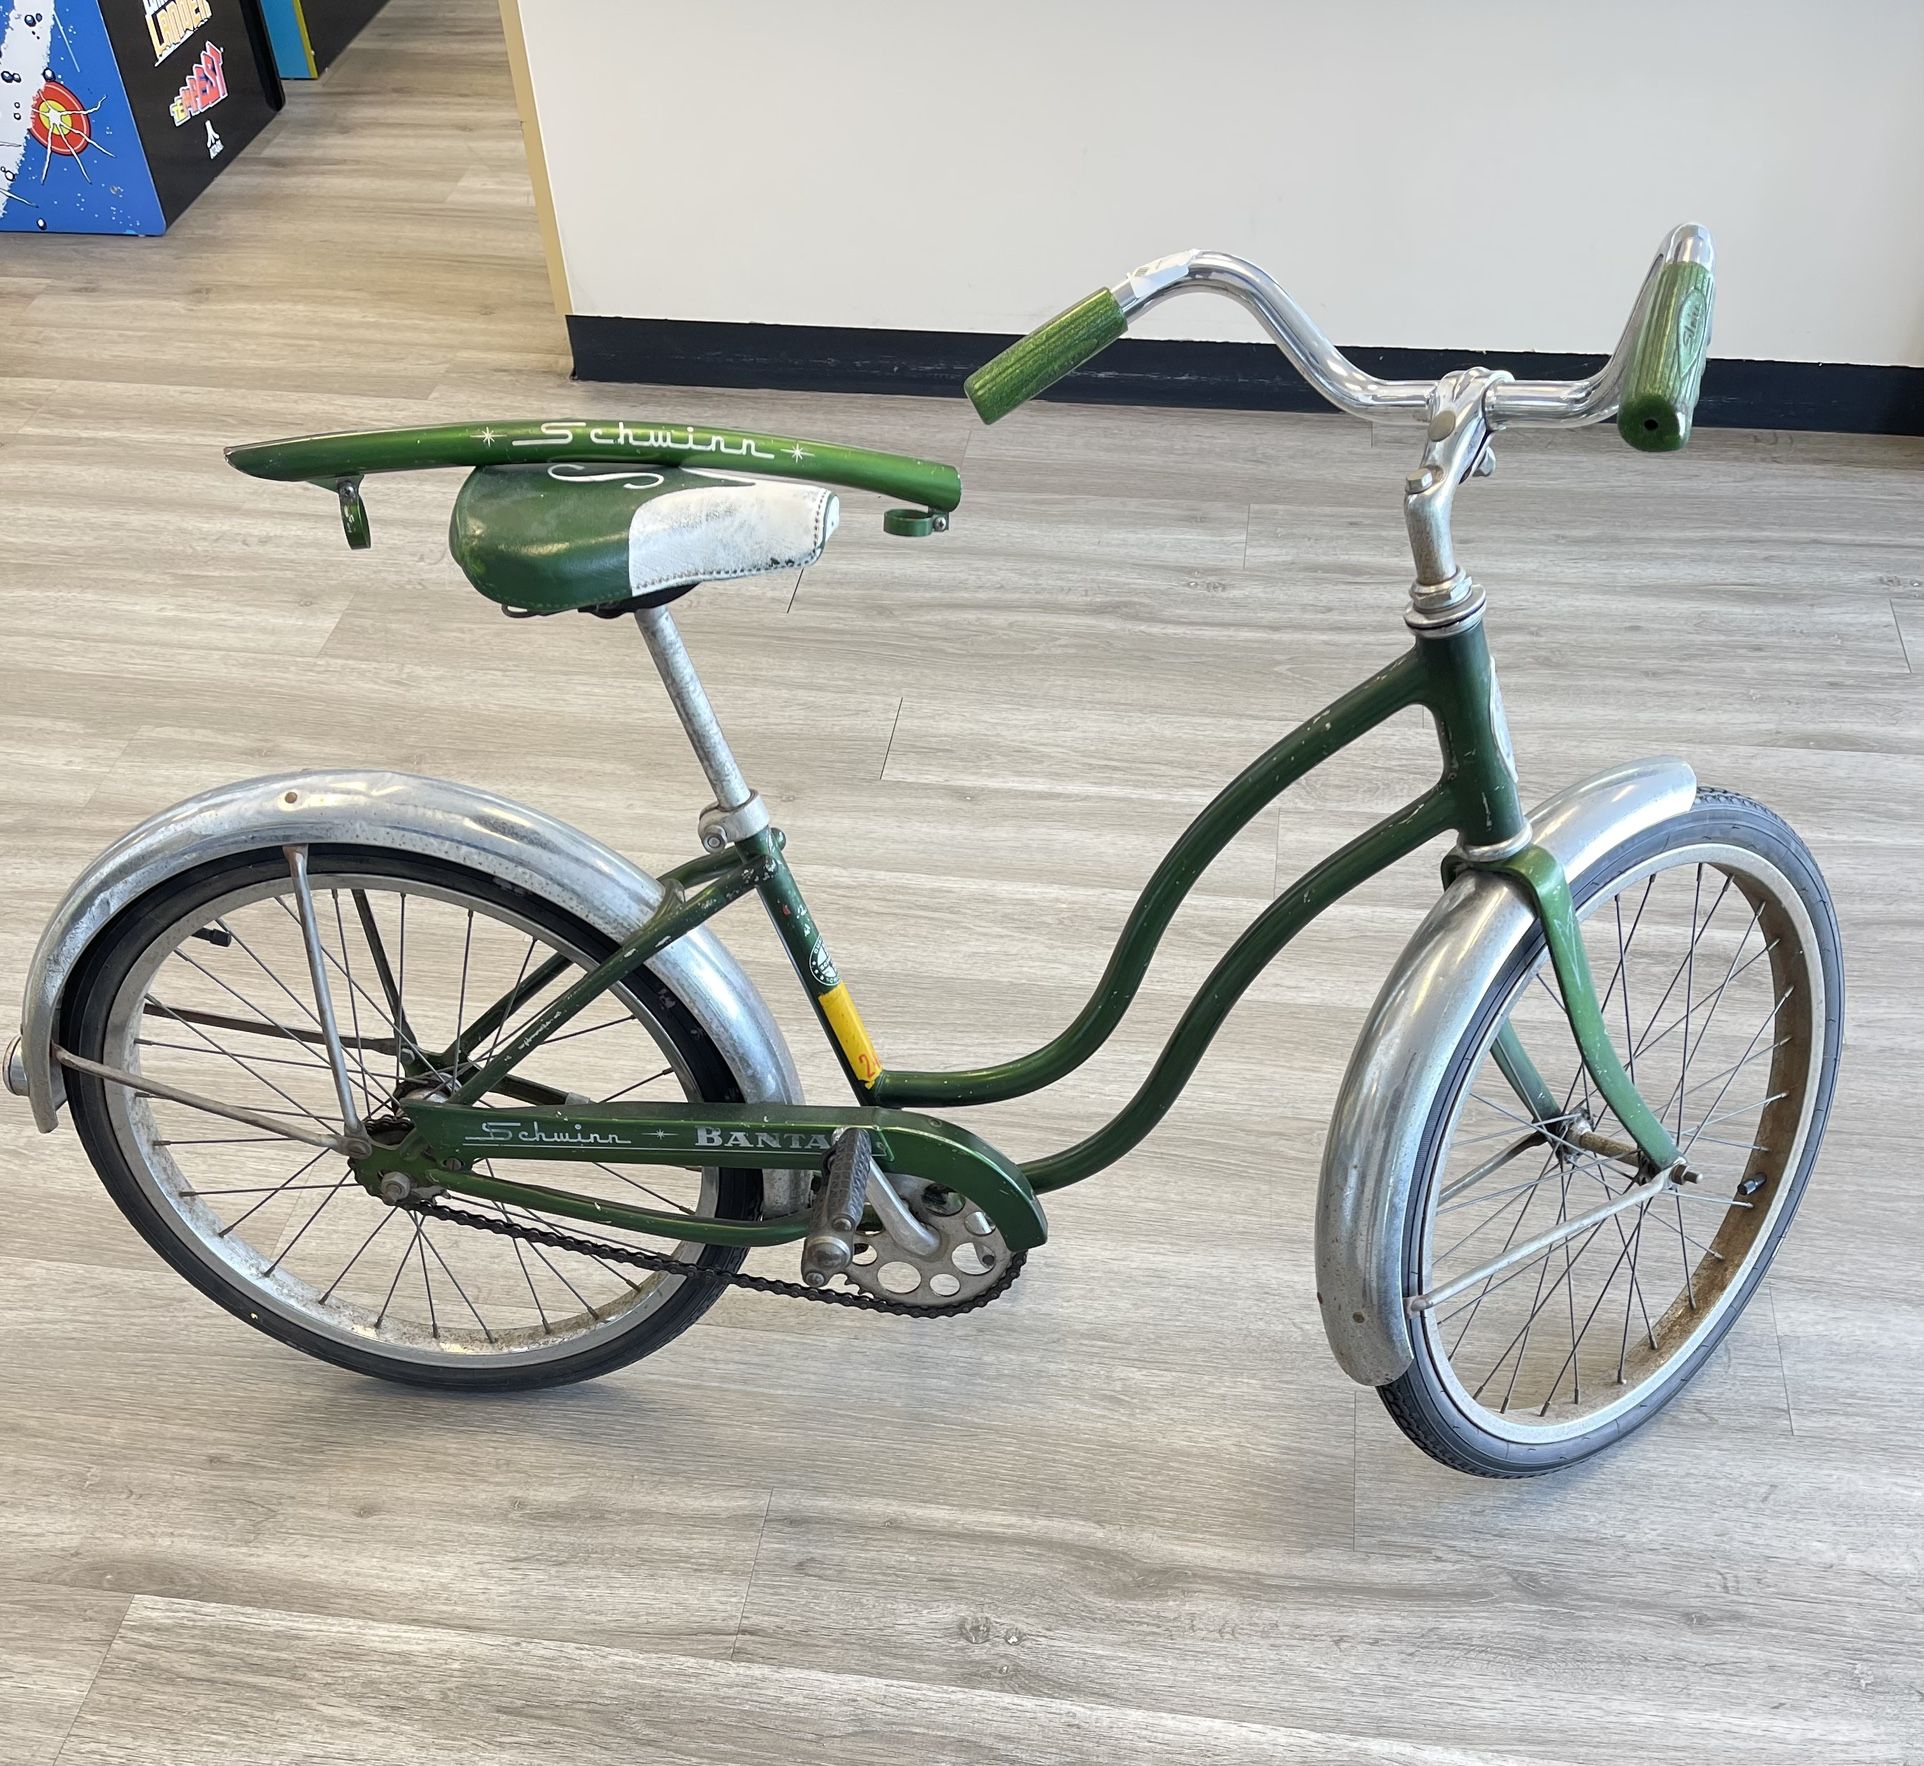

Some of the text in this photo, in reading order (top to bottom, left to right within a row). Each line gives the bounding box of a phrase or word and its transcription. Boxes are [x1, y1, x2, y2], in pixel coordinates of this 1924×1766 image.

[169, 41, 229, 126] TEMPEST
[511, 421, 776, 460] Schwinn
[464, 1121, 832, 1149] Schwinn BANTA
